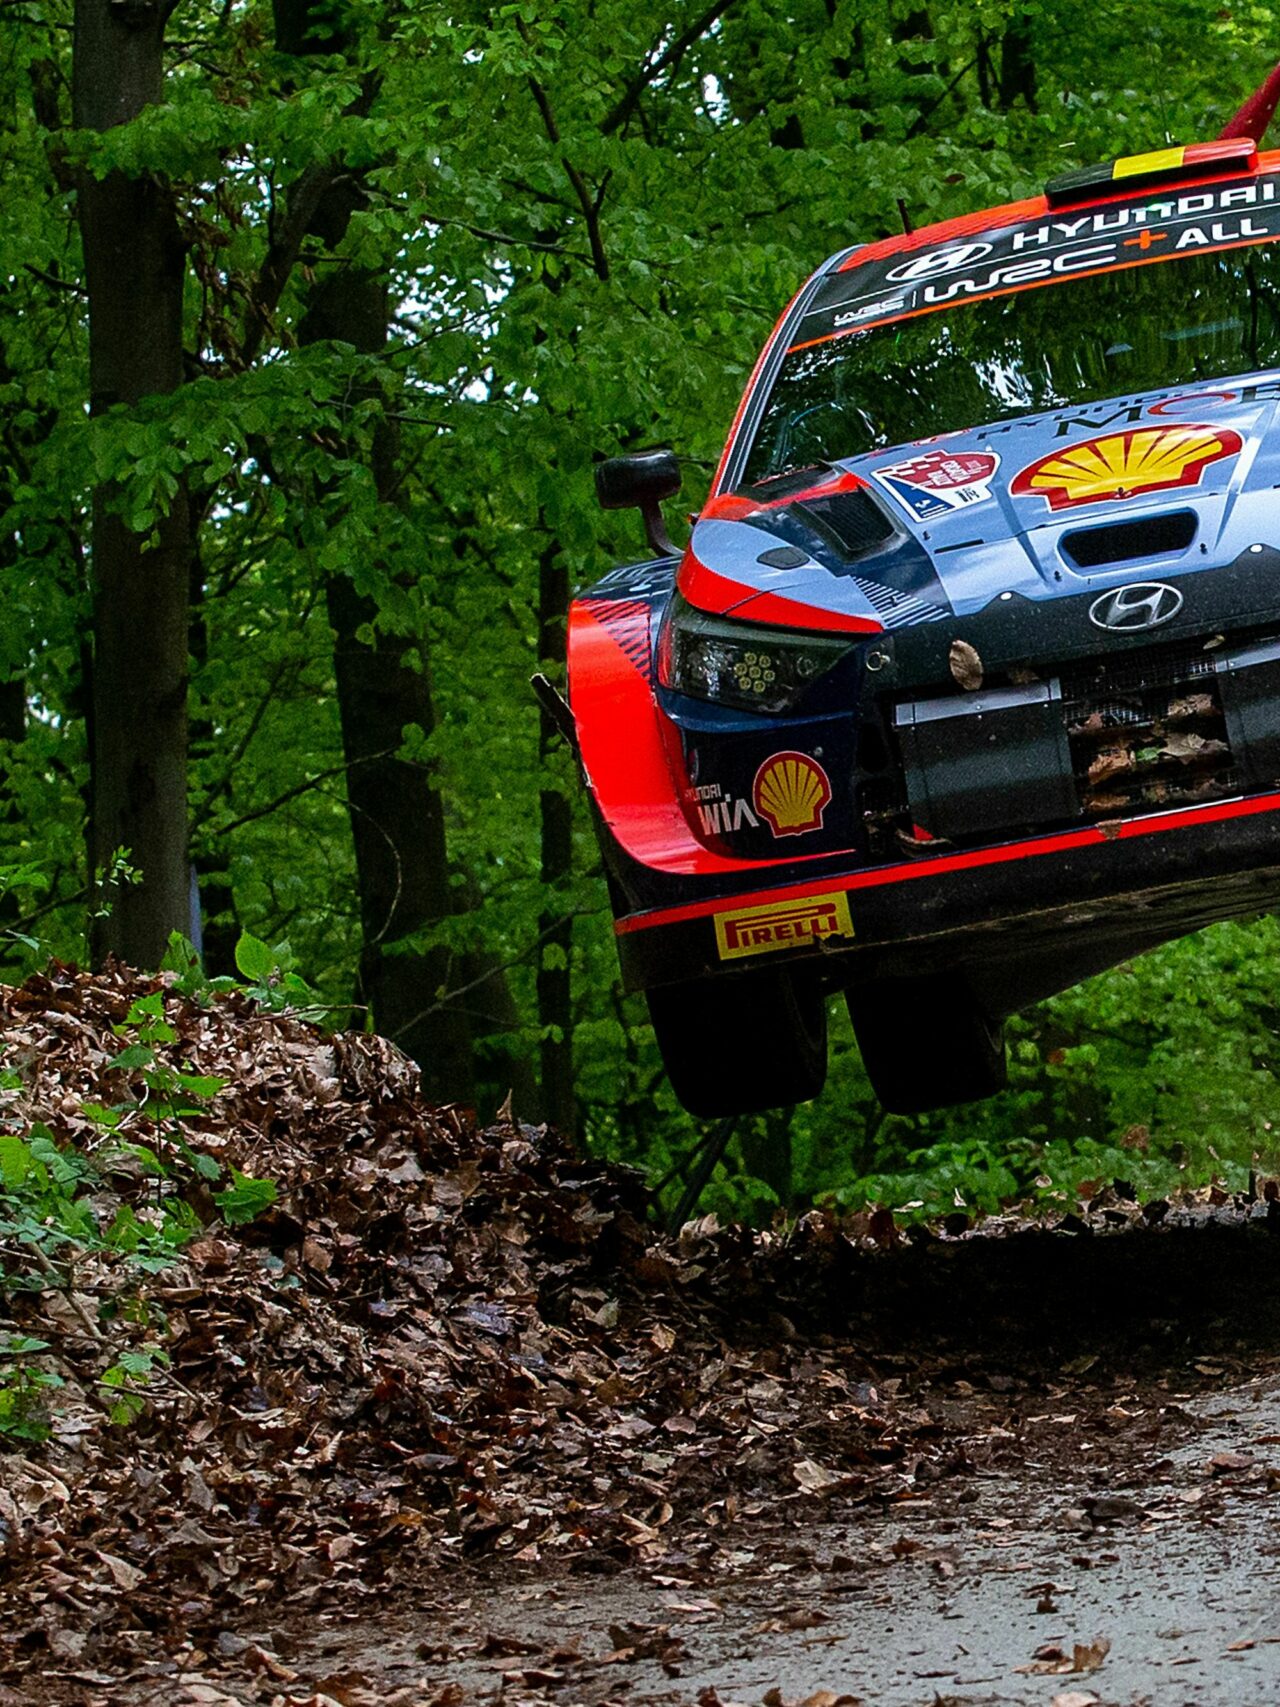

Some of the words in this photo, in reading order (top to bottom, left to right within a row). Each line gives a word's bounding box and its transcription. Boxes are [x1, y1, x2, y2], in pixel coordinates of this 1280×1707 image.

[1012, 182, 1275, 250] HYUNDAI
[1175, 218, 1269, 249] ALL
[723, 902, 839, 949] PIRELLI
